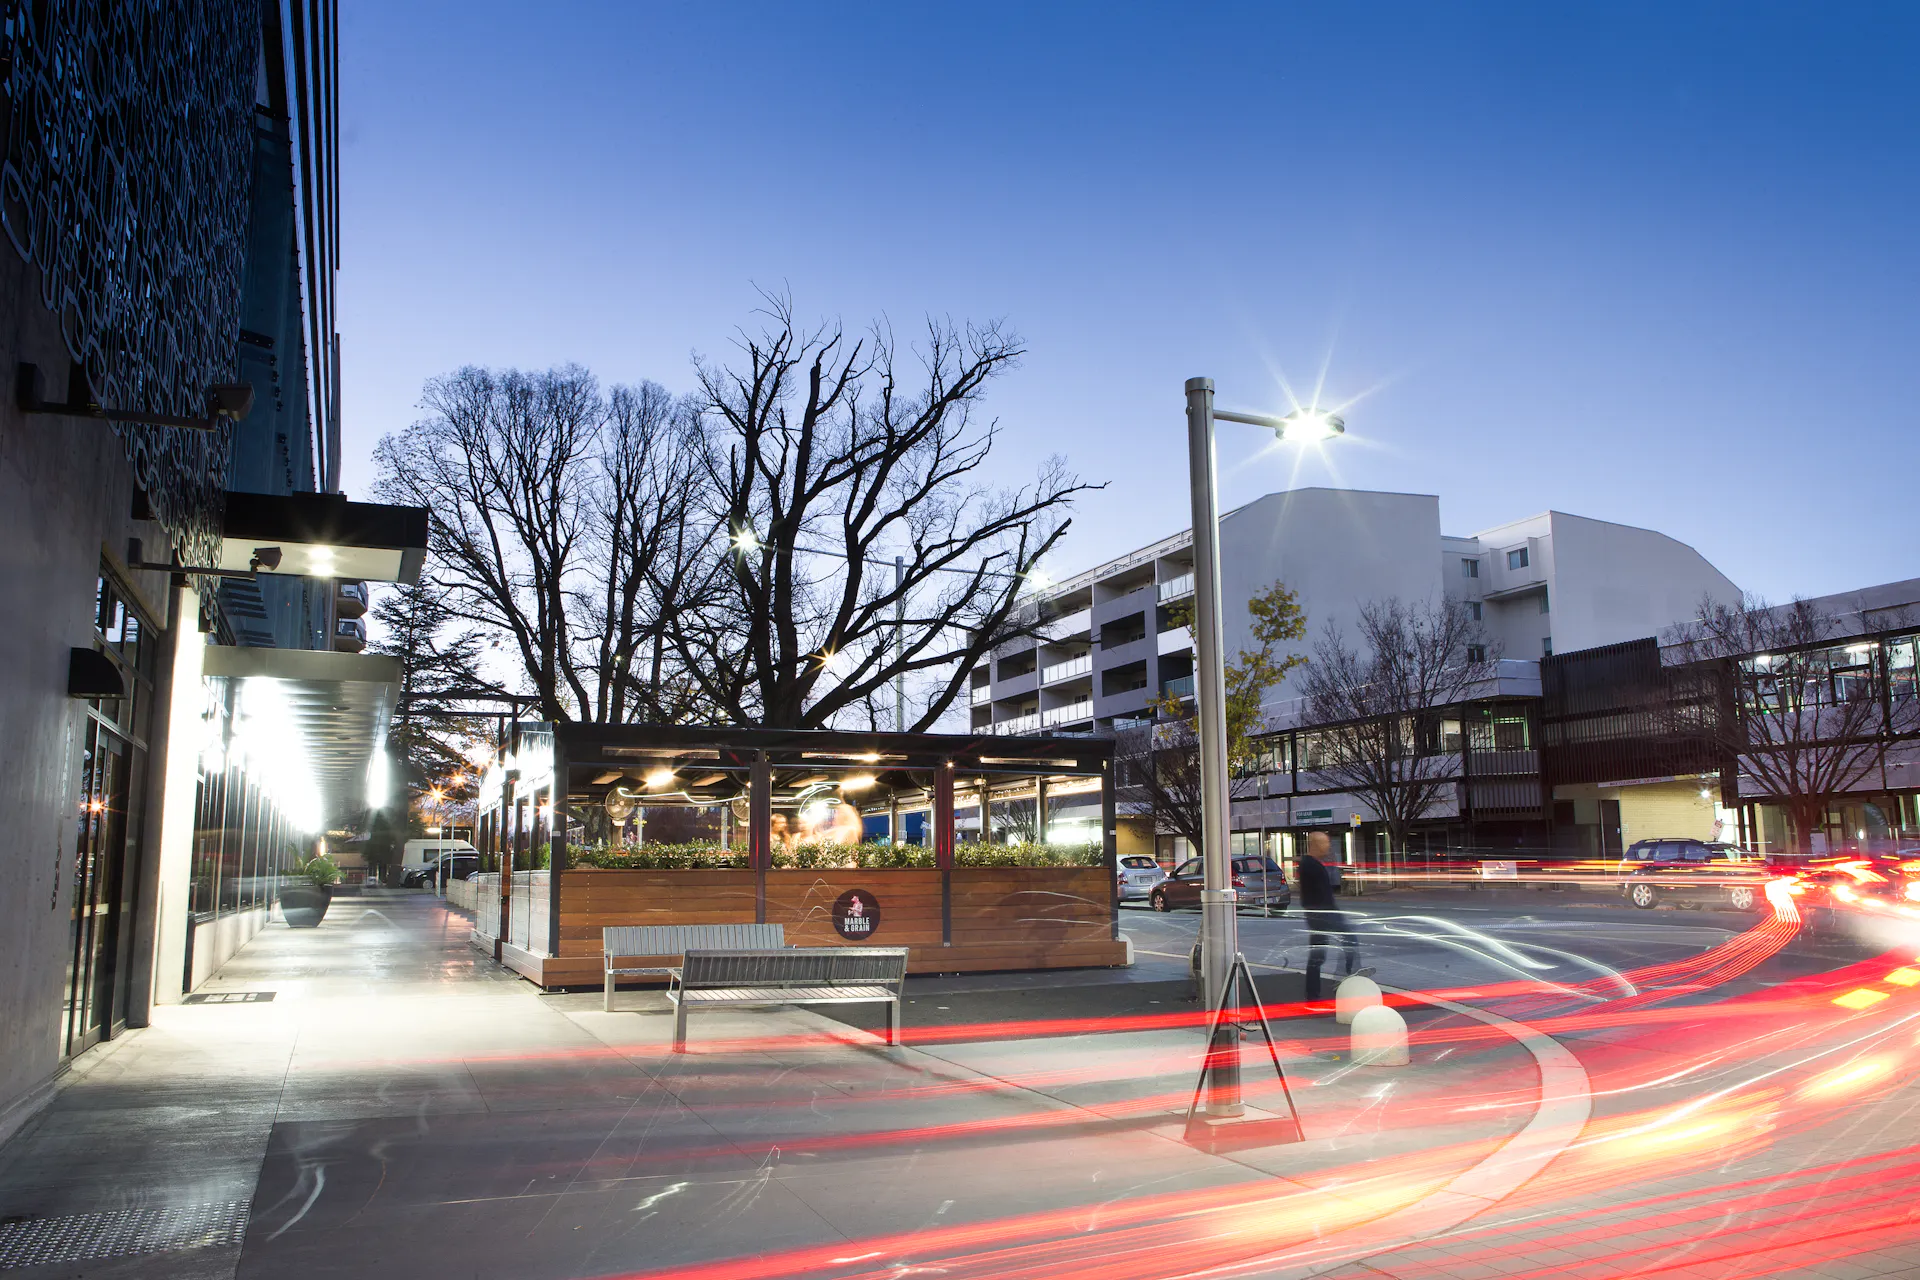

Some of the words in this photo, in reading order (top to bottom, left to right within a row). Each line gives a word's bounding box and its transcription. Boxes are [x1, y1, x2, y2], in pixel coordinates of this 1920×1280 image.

[844, 917, 870, 925] MARBLE
[844, 924, 850, 932] &
[850, 924, 870, 932] GRAIN
